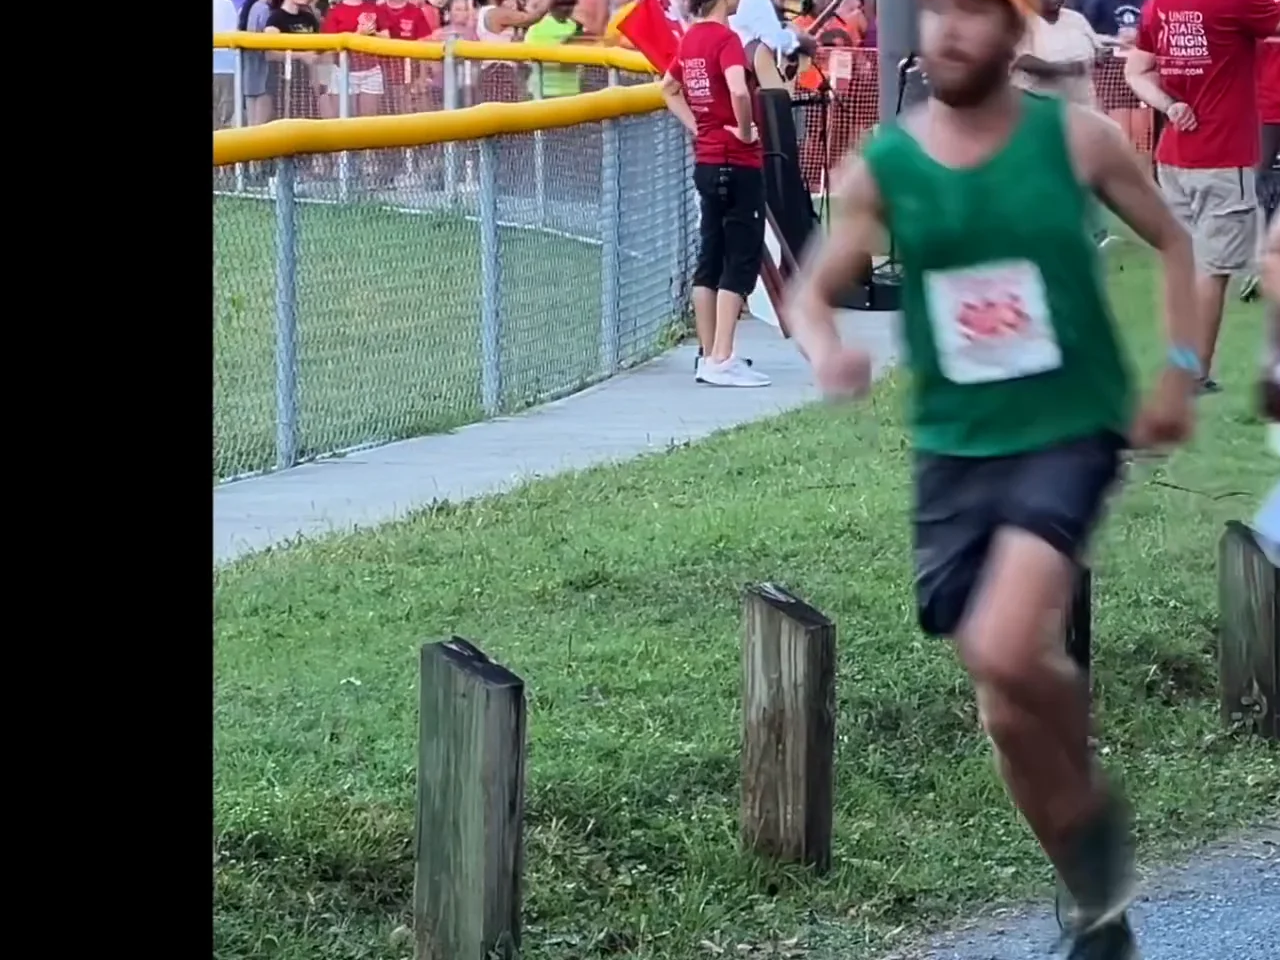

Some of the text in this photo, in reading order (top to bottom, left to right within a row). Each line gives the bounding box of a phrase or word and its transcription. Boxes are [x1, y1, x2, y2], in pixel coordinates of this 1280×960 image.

[1168, 11, 1203, 23] UNITED
[1169, 23, 1205, 35] STATES
[1169, 35, 1208, 47] VIRGIN
[1169, 47, 1209, 57] ISLANDS
